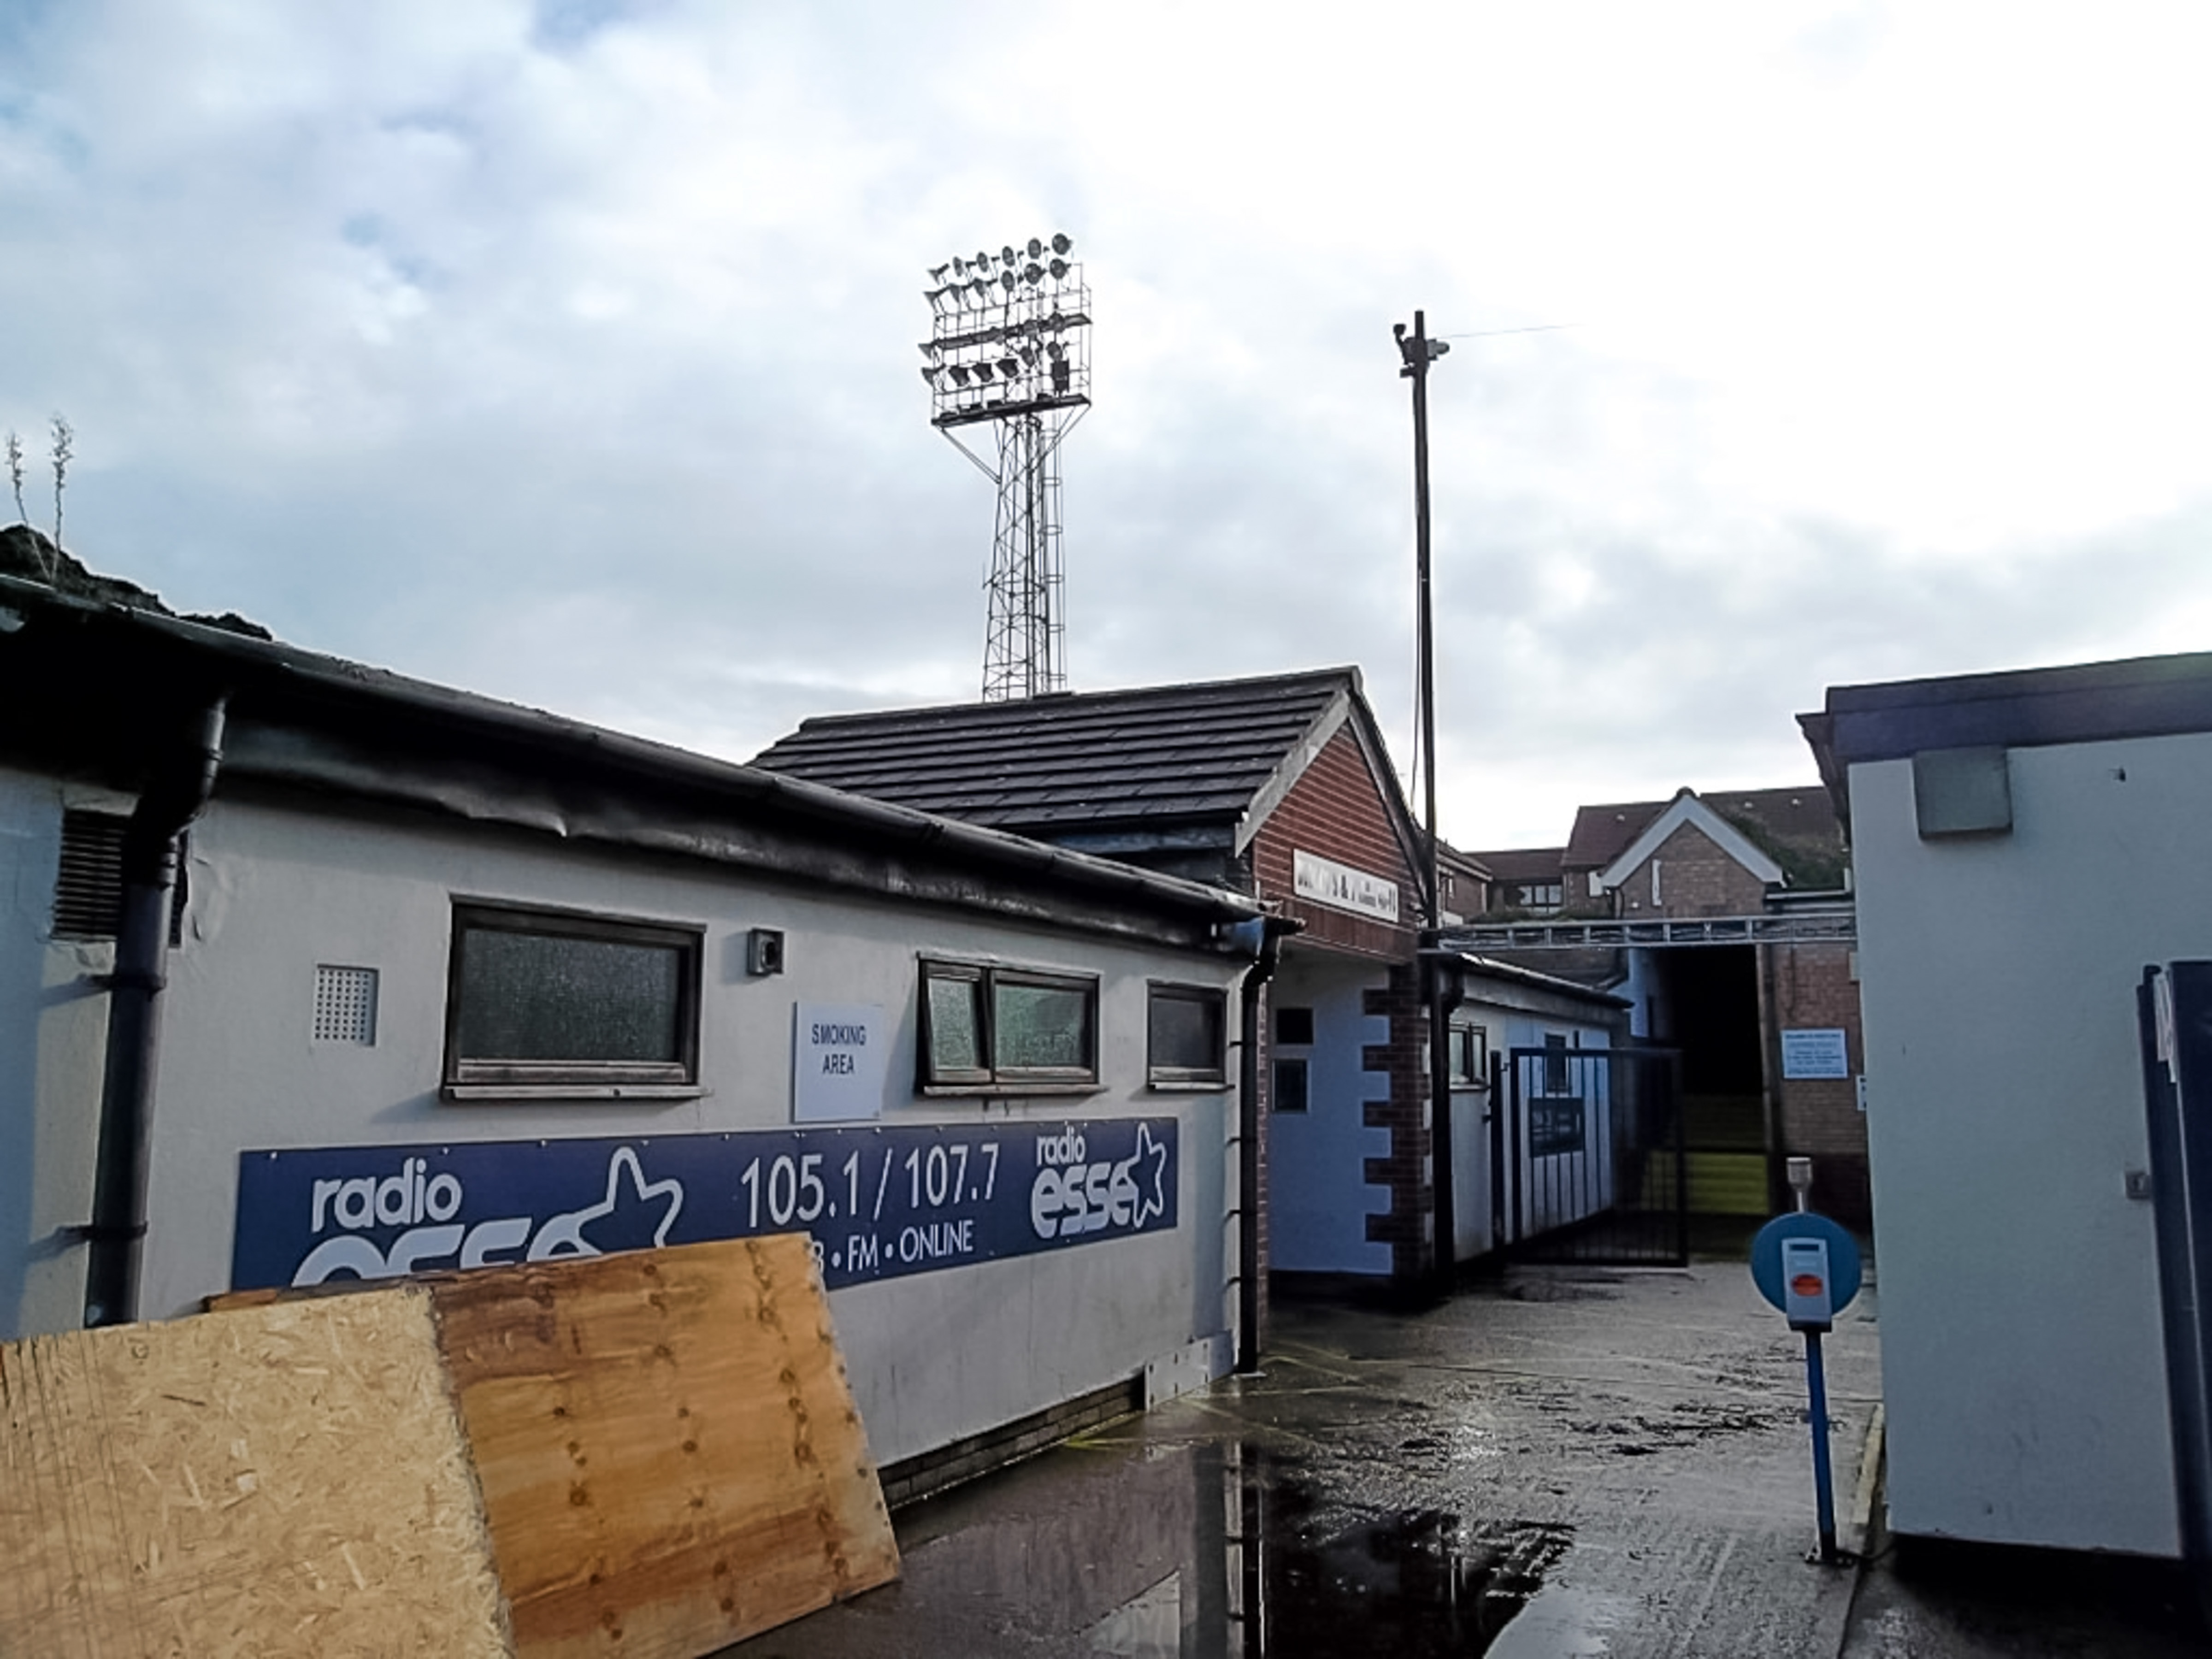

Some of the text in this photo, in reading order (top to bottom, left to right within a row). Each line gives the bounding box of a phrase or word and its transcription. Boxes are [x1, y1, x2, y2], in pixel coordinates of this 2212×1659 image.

[812, 1023, 867, 1046] SMOKING
[822, 1054, 854, 1075] AREA
[1037, 1125, 1086, 1167] radio
[312, 1157, 462, 1233] radio
[741, 1150, 858, 1228] 105.1
[905, 1142, 999, 1209] 107.7
[900, 1219, 973, 1263] ONLINE
